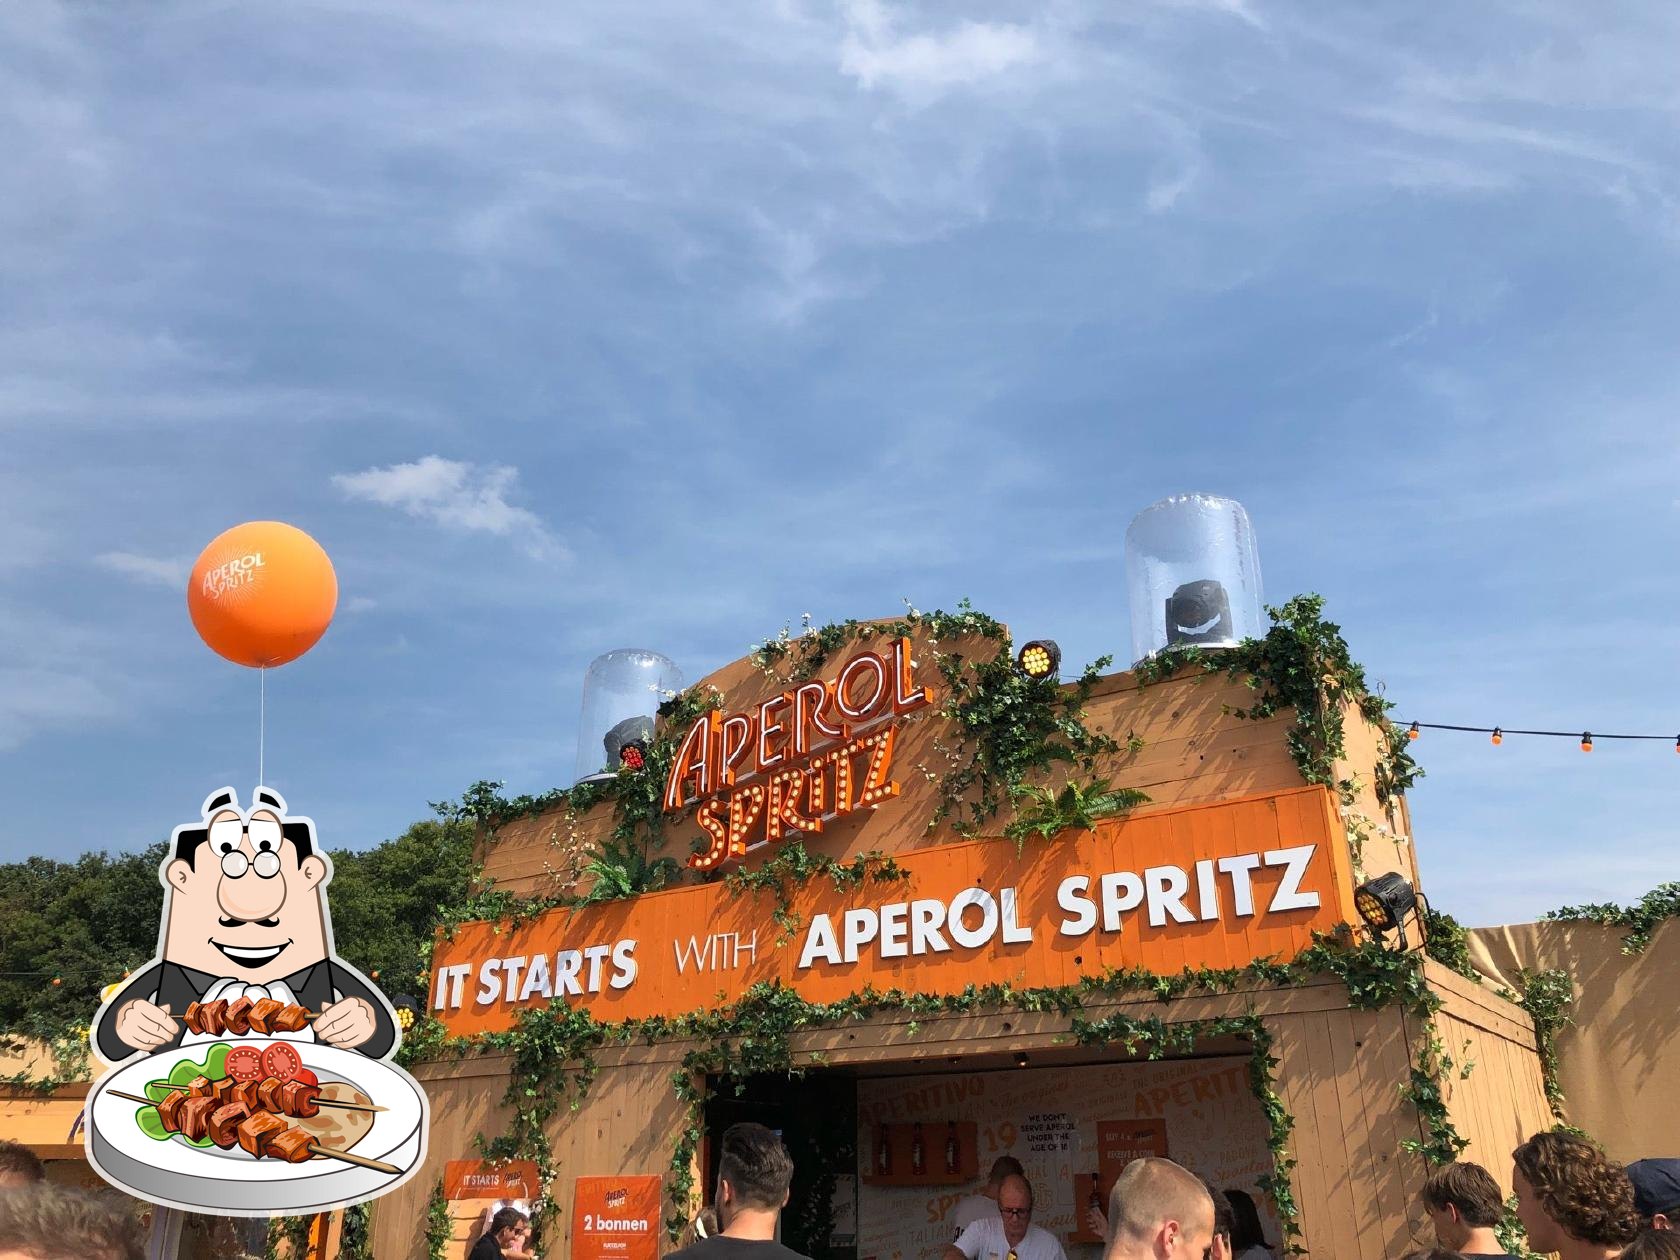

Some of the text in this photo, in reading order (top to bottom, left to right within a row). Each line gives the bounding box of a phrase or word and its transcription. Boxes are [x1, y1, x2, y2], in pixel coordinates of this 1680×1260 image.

[203, 552, 266, 597] APEROL
[211, 568, 255, 600] SPRITZ
[664, 637, 933, 812] APEROL
[688, 725, 900, 871] SPRITZ
[434, 843, 1321, 1011] IT STARTS WITH APEROL SPRITZ
[1028, 1112, 1067, 1122] WE DON'T
[1020, 1122, 1075, 1132] SERVE APEROL
[1027, 1132, 1070, 1142] UNDER THE
[1030, 1143, 1046, 1152] AGE
[471, 1173, 500, 1186] STARTS
[584, 1213, 648, 1231] 2 bonnen
